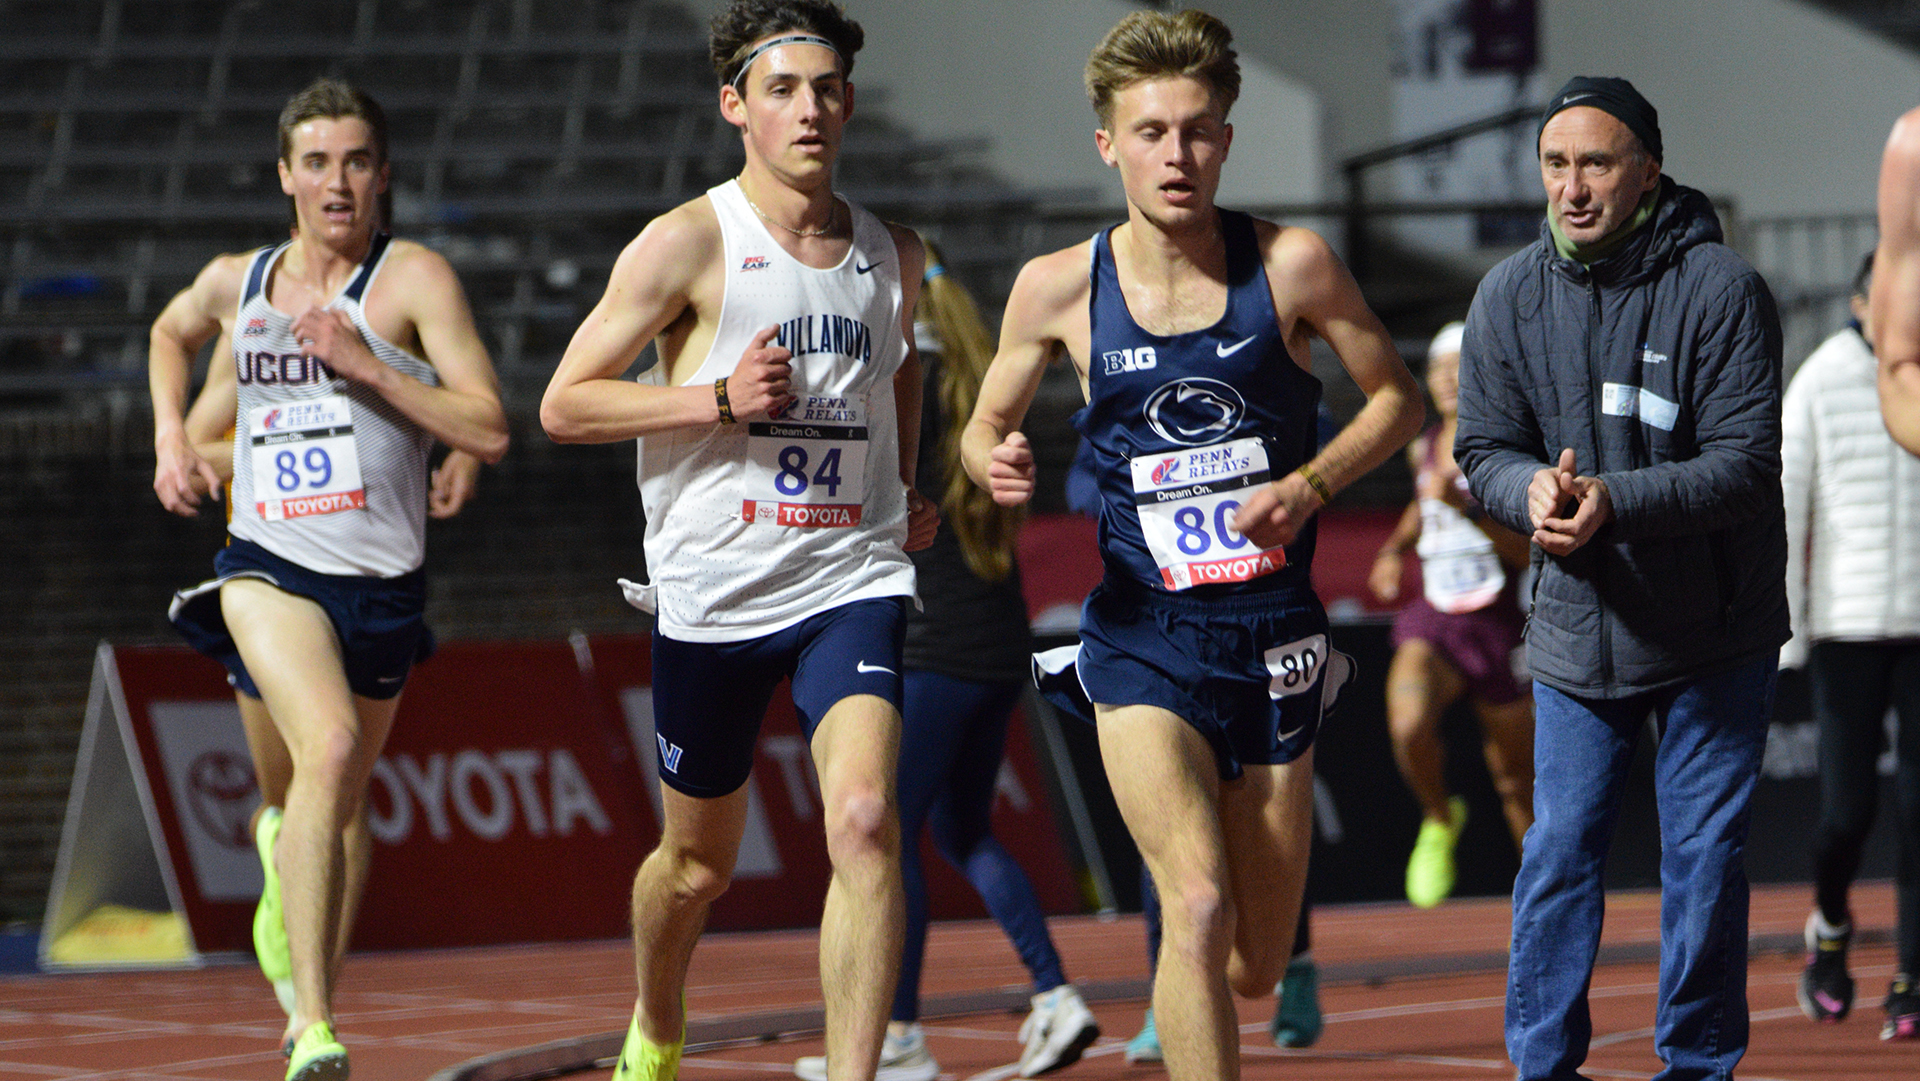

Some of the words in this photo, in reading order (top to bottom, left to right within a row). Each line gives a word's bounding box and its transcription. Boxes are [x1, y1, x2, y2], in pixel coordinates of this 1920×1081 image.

[776, 314, 871, 367] VILLANOVA
[235, 350, 337, 386] UCON
[288, 404, 322, 416] PENN
[806, 397, 848, 409] PENN
[287, 413, 335, 427] RELAYS
[803, 409, 857, 422] RELAYS
[770, 426, 803, 436] Dream
[804, 427, 821, 437] On.
[1188, 447, 1233, 465] PENN
[275, 446, 332, 492] 89
[774, 445, 842, 497] 84
[1188, 457, 1250, 478] RELAYS
[1156, 488, 1192, 502] Dream
[1192, 485, 1213, 496] On.
[284, 494, 354, 516] TOYOTA
[783, 506, 851, 524] TOYOTA
[1174, 500, 1249, 556] 80
[1192, 555, 1275, 580] TOYOTA
[1281, 648, 1317, 688] 80
[367, 748, 612, 843] OYOTA
